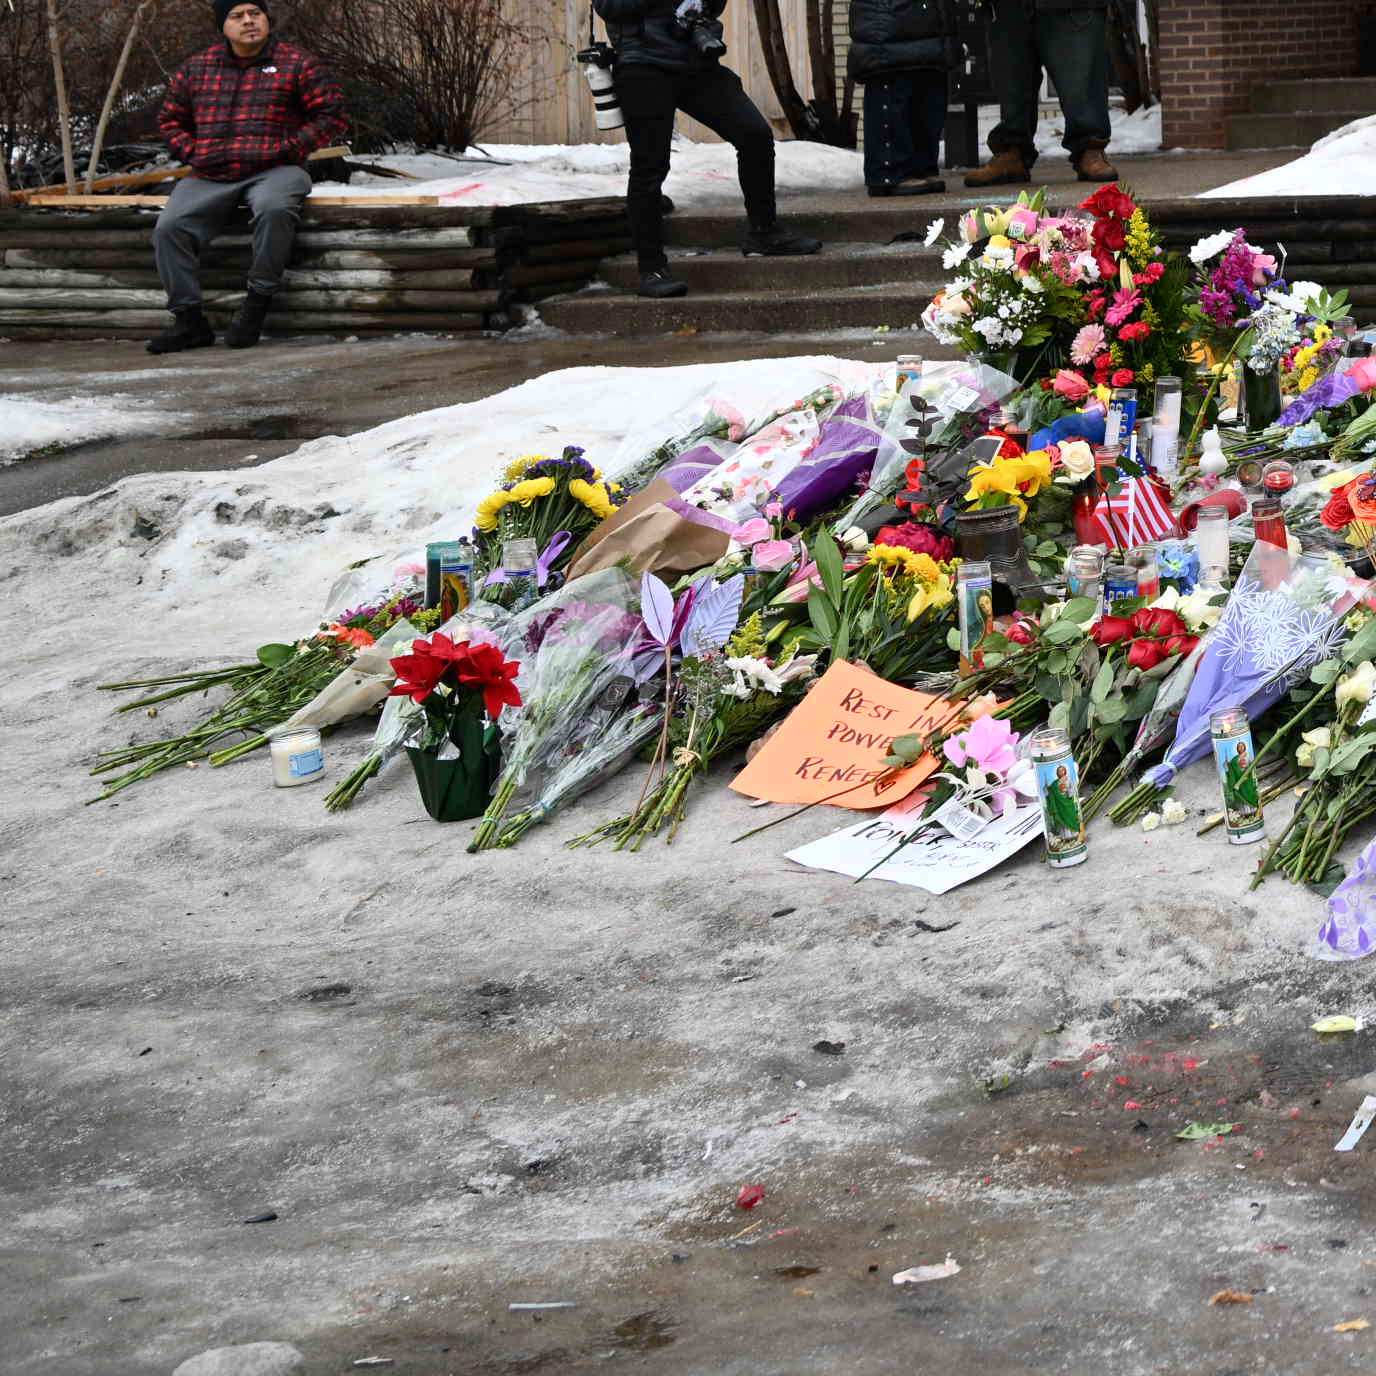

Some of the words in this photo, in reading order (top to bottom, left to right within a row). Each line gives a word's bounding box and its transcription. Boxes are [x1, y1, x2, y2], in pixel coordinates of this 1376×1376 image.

[840, 687, 899, 721] REST
[907, 714, 948, 732] IN
[826, 720, 895, 750] POWE
